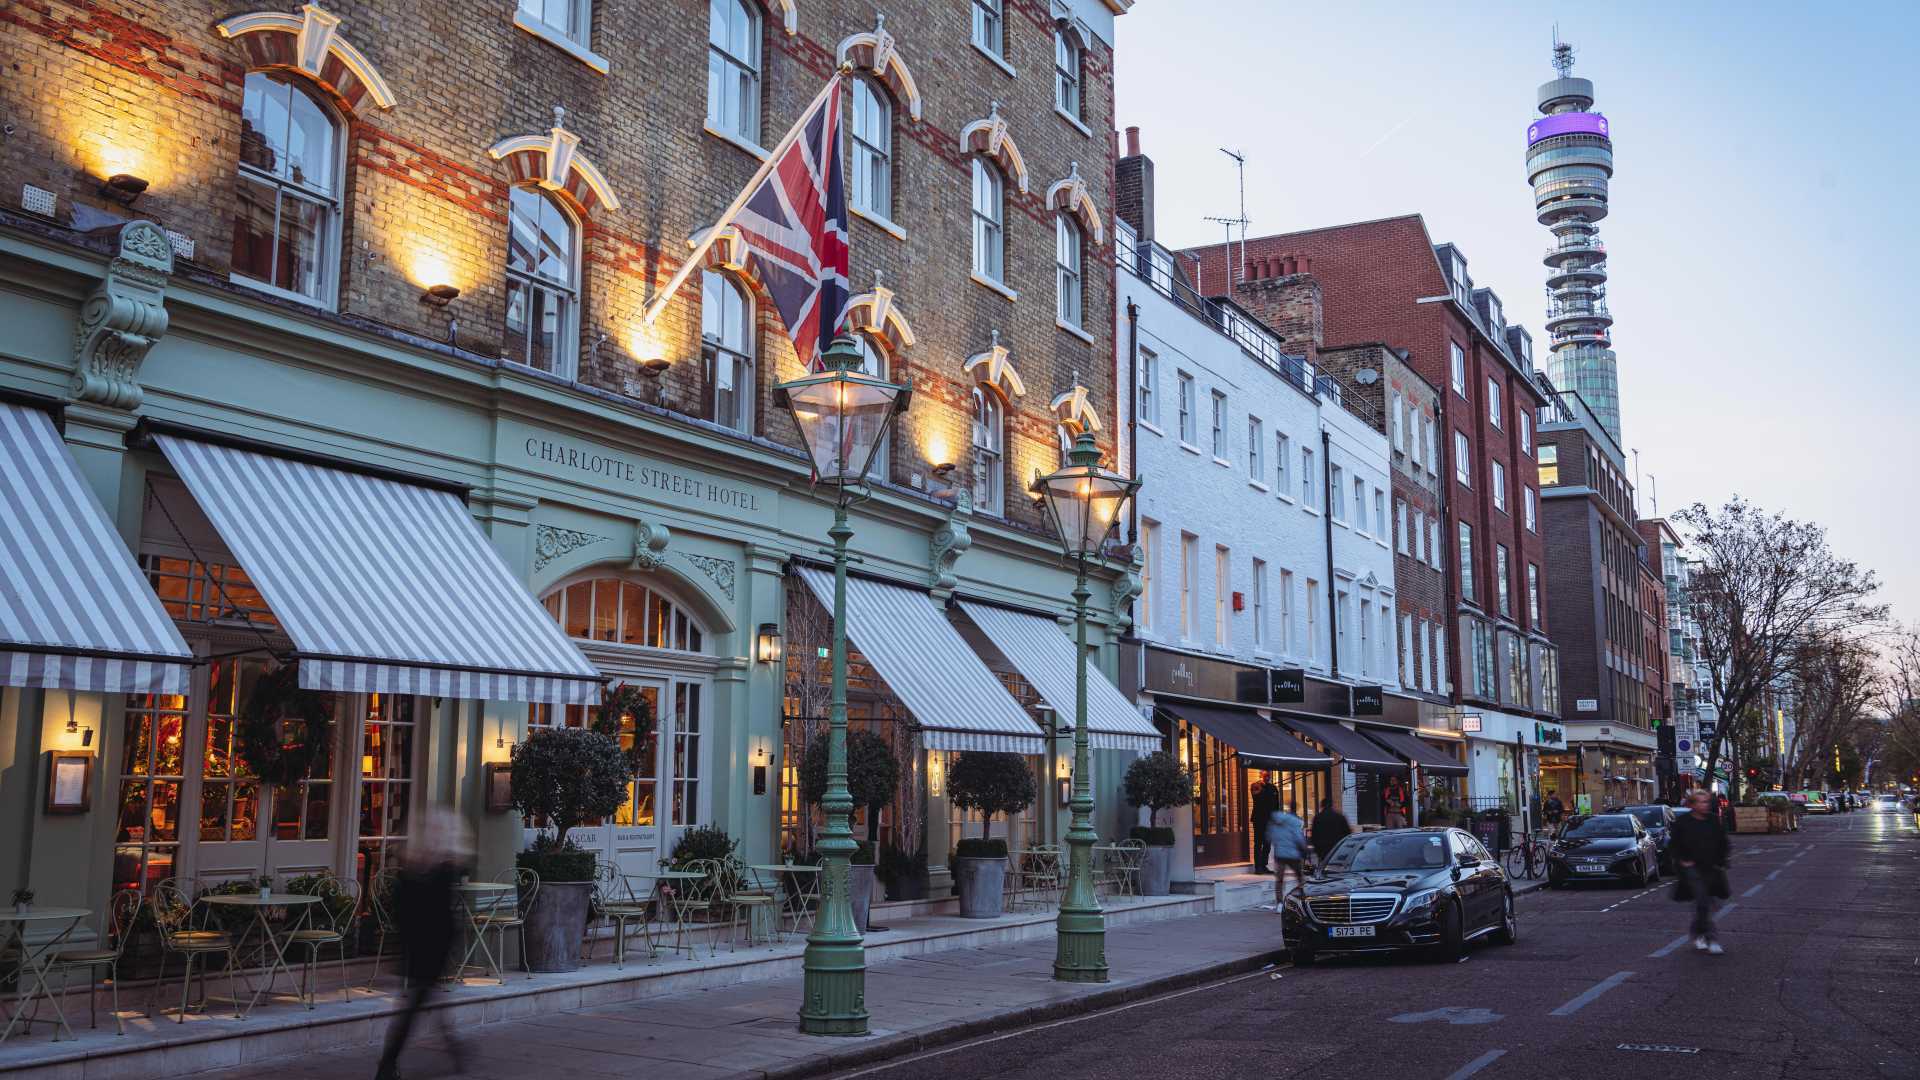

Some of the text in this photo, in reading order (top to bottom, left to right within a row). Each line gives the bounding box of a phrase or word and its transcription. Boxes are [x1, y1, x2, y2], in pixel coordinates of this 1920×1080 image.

[525, 437, 760, 511] CHARLOTTE STREET HOTEL
[1336, 927, 1355, 936] 5173
